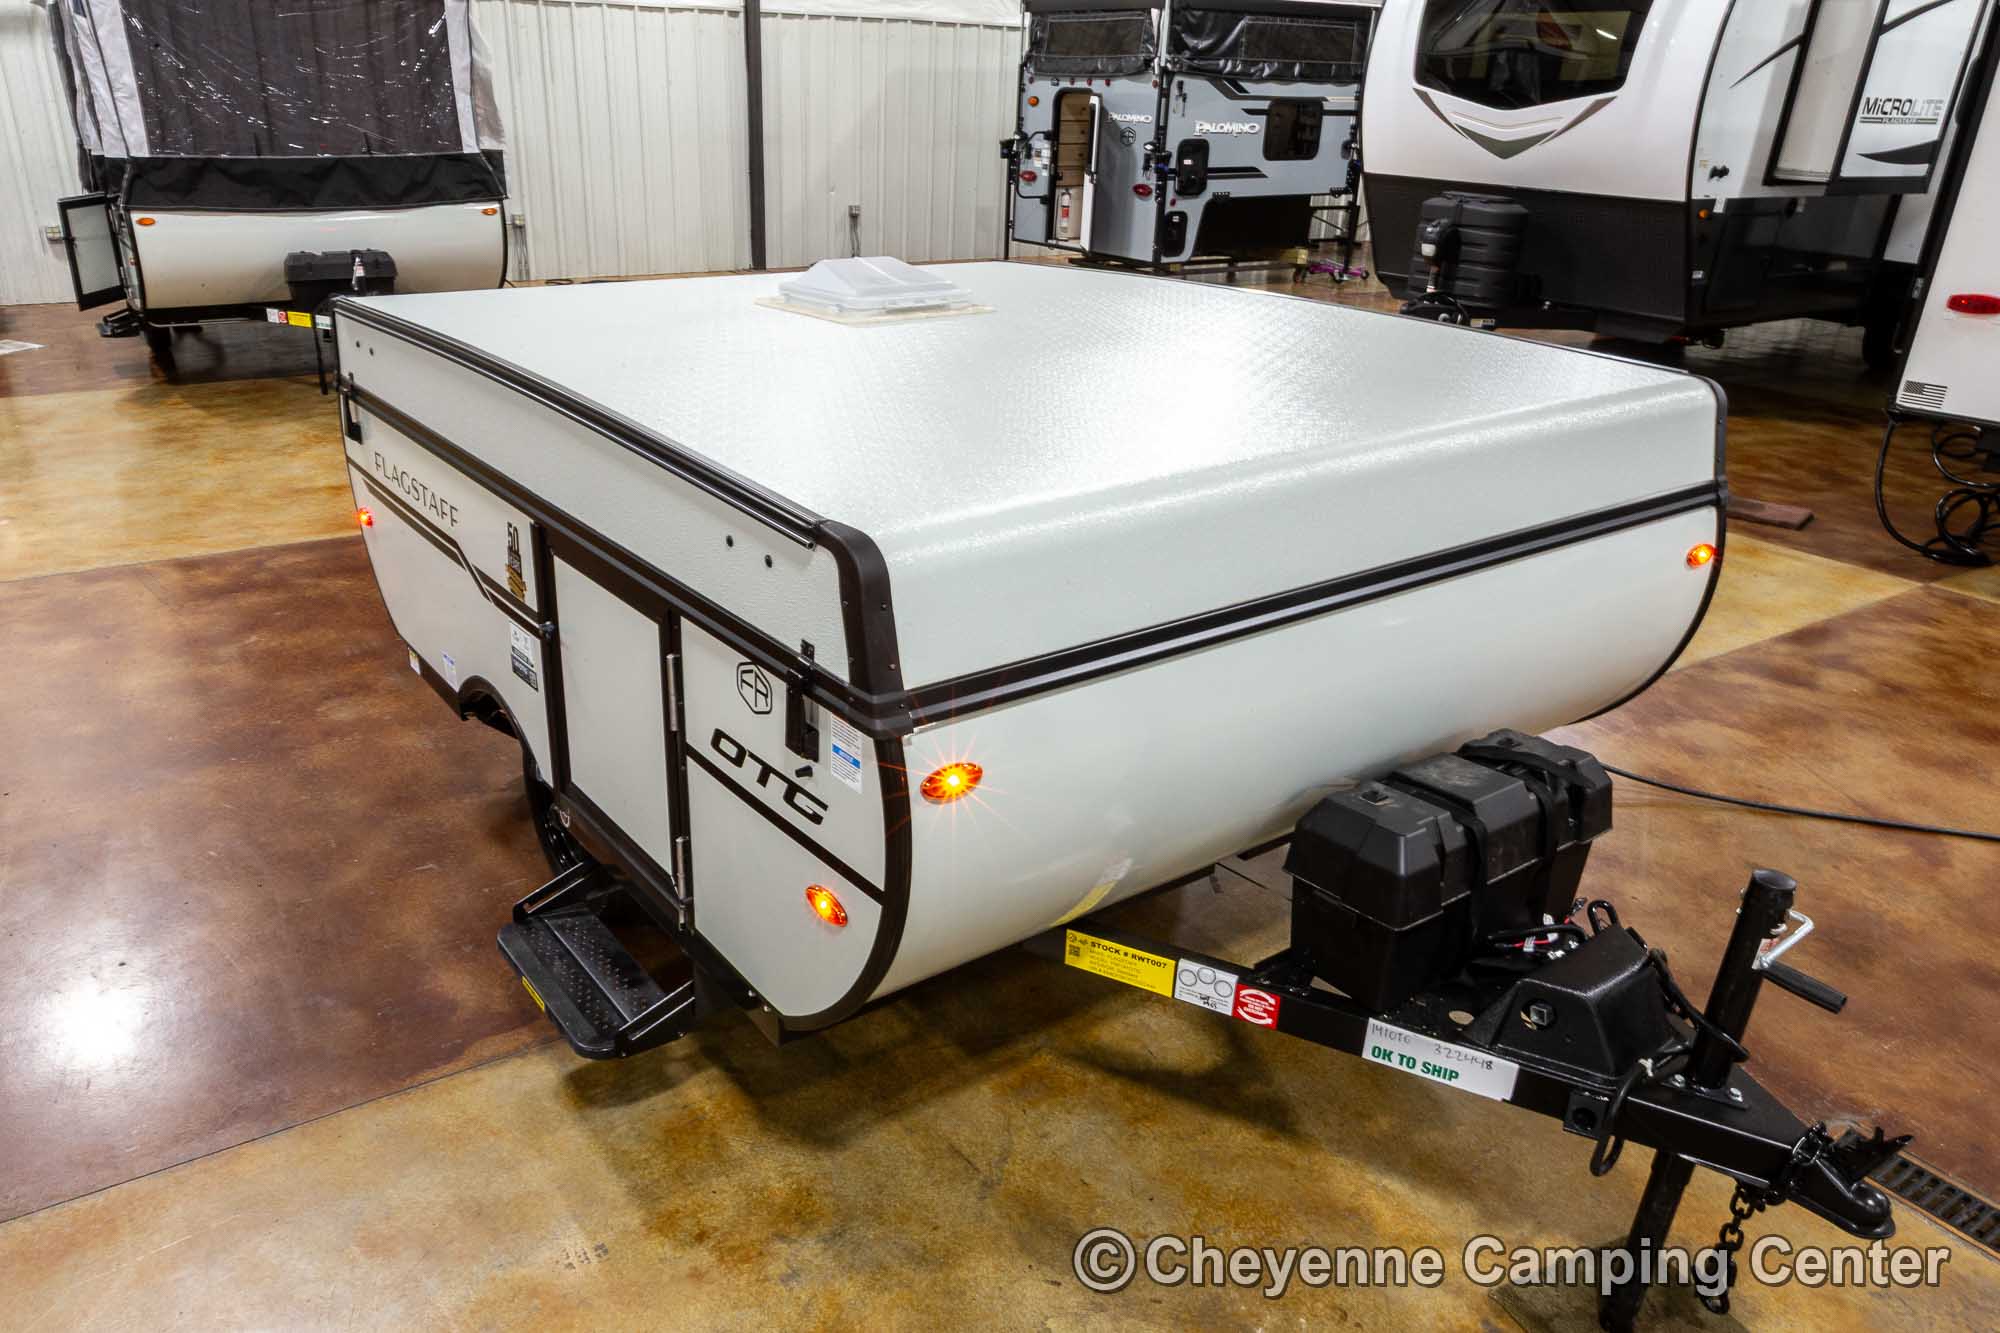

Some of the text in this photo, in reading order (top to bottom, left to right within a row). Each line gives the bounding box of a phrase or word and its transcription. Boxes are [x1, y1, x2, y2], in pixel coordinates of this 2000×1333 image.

[1194, 120, 1261, 137] PALOMINO
[374, 452, 459, 527] FLAGSTAFF
[711, 728, 828, 826] OTG
[1090, 941, 1120, 955] STOCK
[1131, 953, 1168, 968] RWT007
[1371, 1045, 1460, 1082] OK TO SHIP
